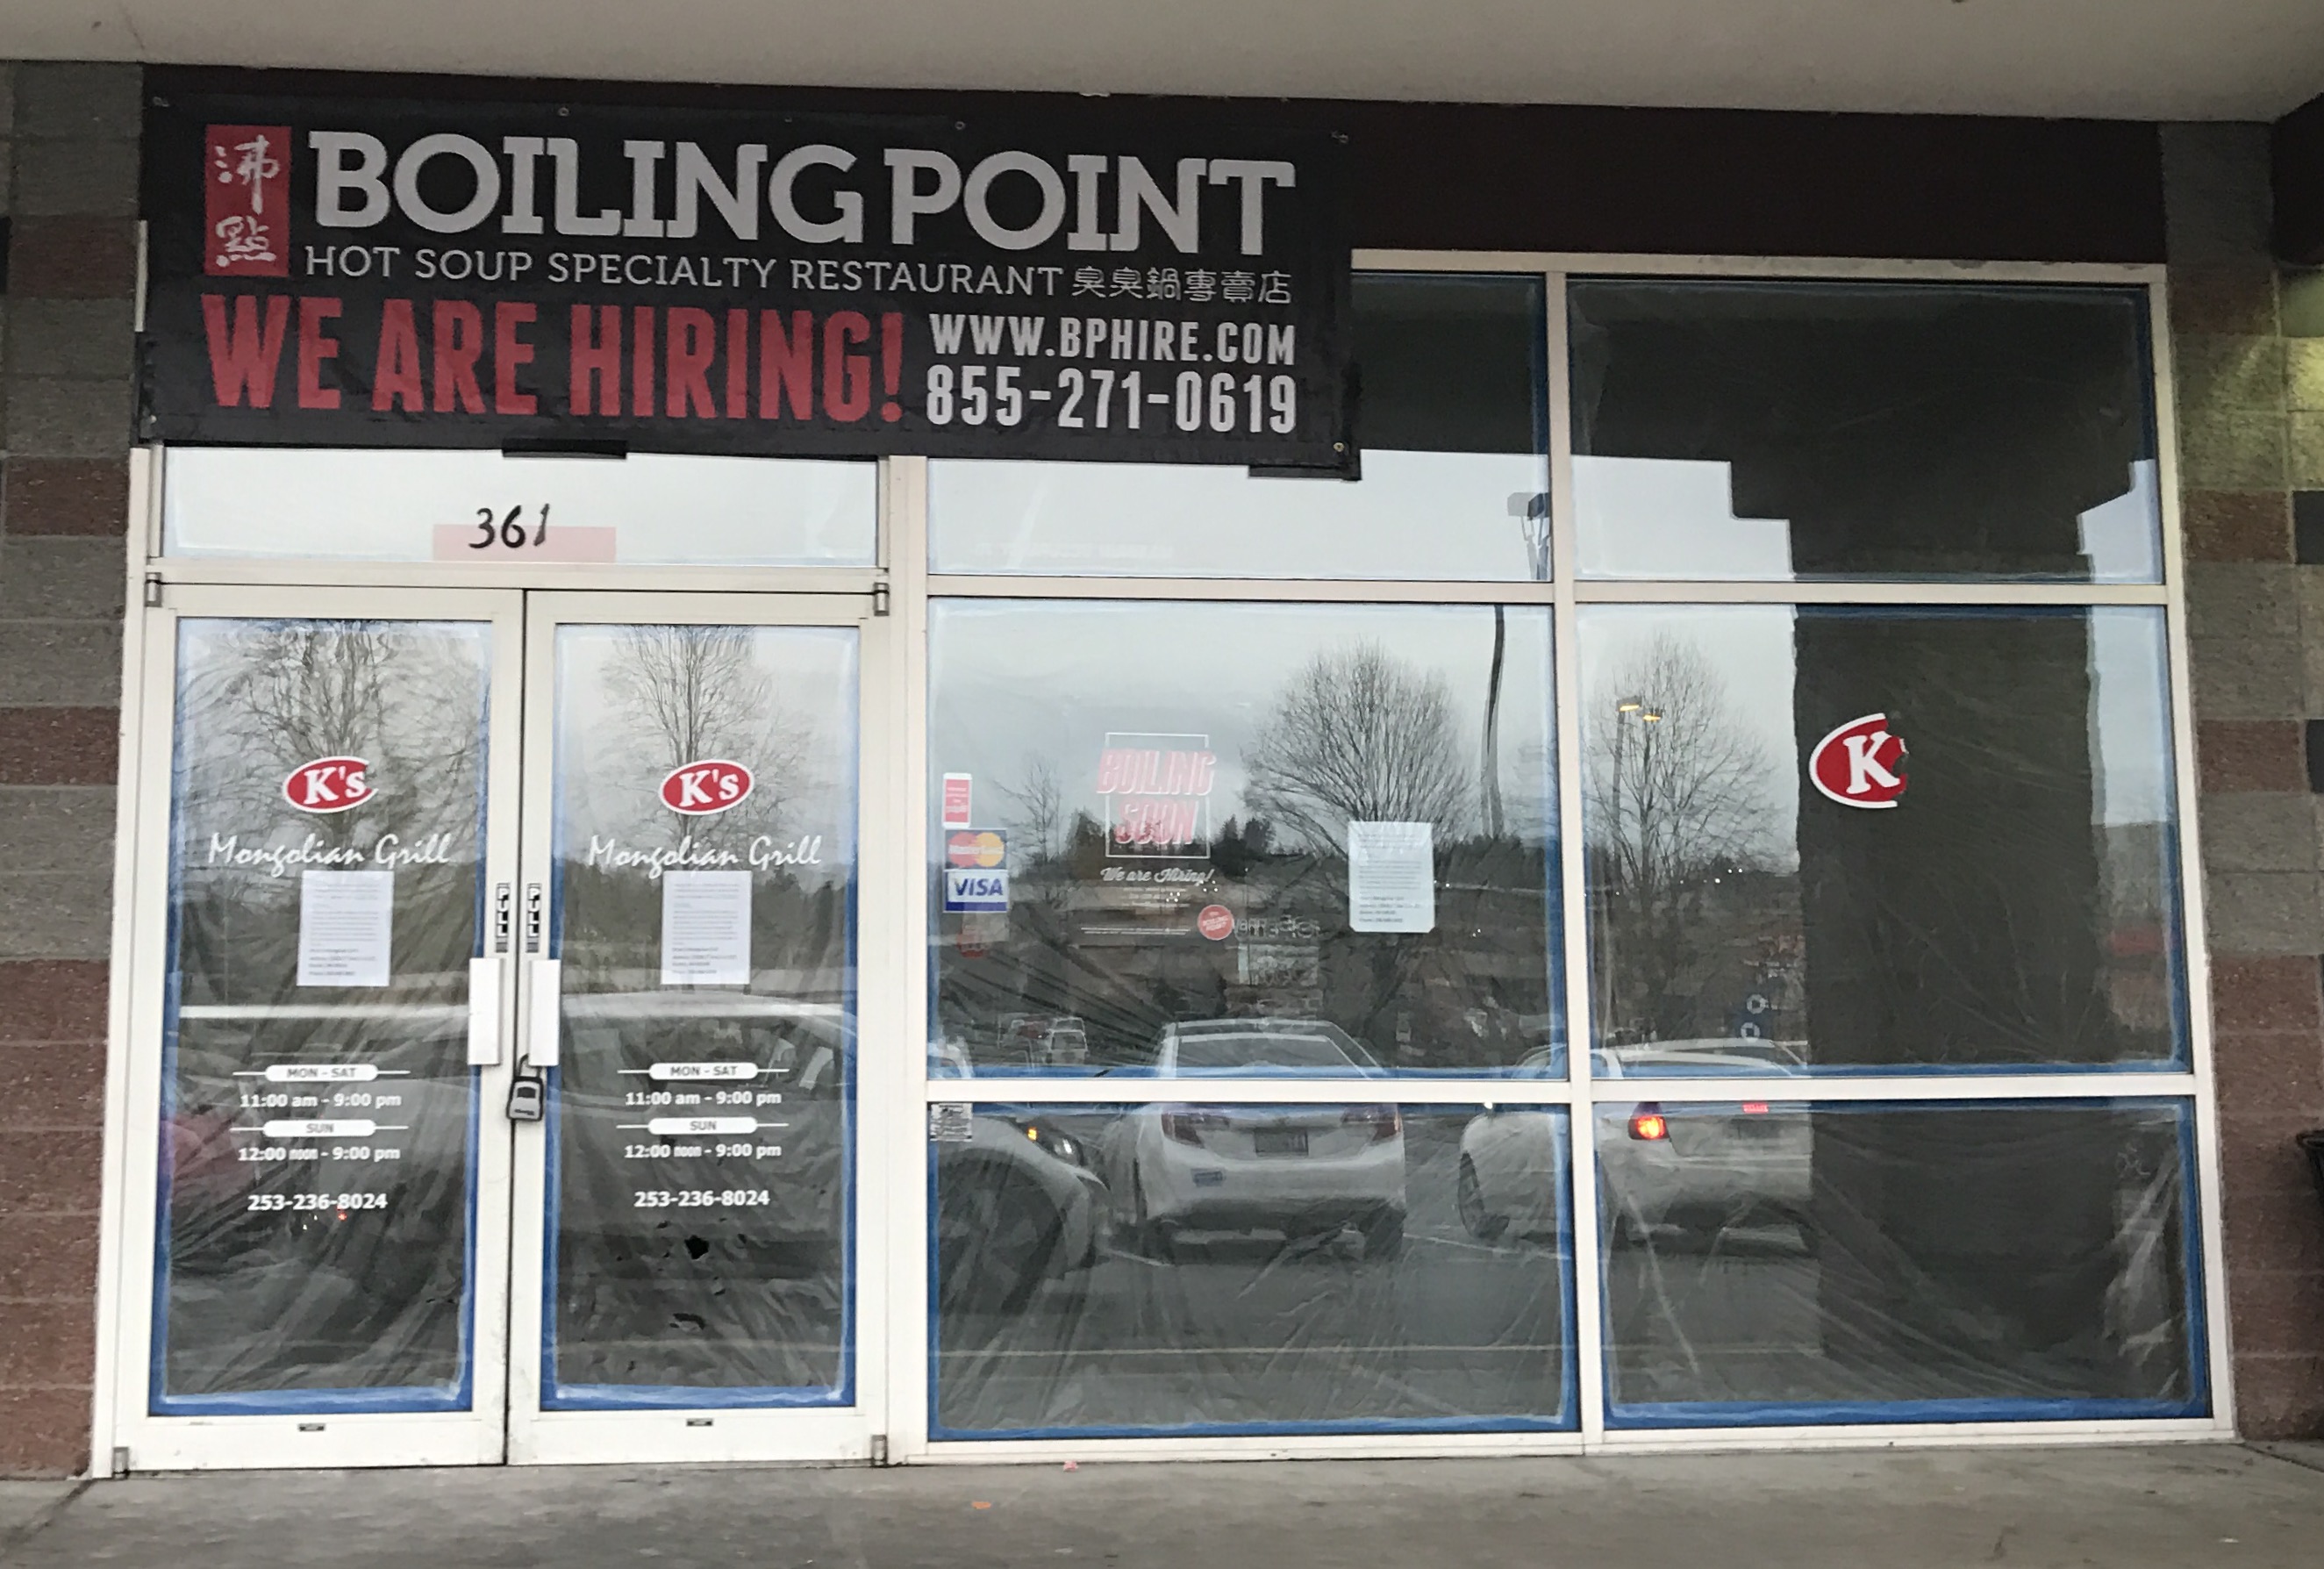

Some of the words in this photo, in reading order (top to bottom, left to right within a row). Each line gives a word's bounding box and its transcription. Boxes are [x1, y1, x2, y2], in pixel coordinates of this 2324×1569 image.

[308, 129, 865, 245] BOILING
[883, 148, 1297, 255] POINT
[304, 247, 400, 277] HOT
[415, 247, 533, 281] SOUP
[547, 252, 777, 289] SPECIALTY
[790, 259, 1064, 297] RESTAURANT
[1071, 265, 1292, 304] 臭臭鍋專賣店
[928, 312, 1297, 365] WWW.BPHIRE.COM
[201, 294, 343, 410] WE
[371, 298, 538, 415] ARE
[569, 304, 904, 423] HIRING!
[926, 364, 1297, 433] 855-271-0619
[468, 503, 550, 548] 361
[303, 765, 367, 805] K's
[679, 769, 740, 807] K's
[1097, 748, 1217, 796] BOILING
[1114, 797, 1199, 845] SOON
[207, 832, 365, 878] Mongolian
[374, 833, 452, 869] Grill
[588, 835, 739, 879] Mongolian
[748, 835, 823, 870] Grill
[954, 878, 1004, 896] VISA
[1100, 866, 1125, 882] We
[1126, 870, 1152, 882] are
[1154, 868, 1215, 887] Hiring!
[497, 887, 510, 937] PULL
[528, 887, 540, 937] PULL
[286, 1067, 318, 1078] MON
[331, 1066, 356, 1078] SAT
[669, 1065, 700, 1077] MON
[713, 1064, 739, 1076] SAT
[240, 1093, 288, 1107] 11:00
[291, 1095, 318, 1107] am
[333, 1093, 372, 1107] 9:00
[375, 1095, 402, 1109] pm
[625, 1091, 672, 1106] 11:00
[675, 1093, 701, 1106] am
[715, 1091, 753, 1105] 9:00
[755, 1093, 783, 1107] pm
[306, 1122, 335, 1134] SUN
[690, 1121, 717, 1131] SUN
[238, 1147, 287, 1162] 12:00
[332, 1146, 370, 1160] 9:00
[374, 1148, 401, 1163] pm
[624, 1144, 671, 1158] 12:00
[715, 1143, 753, 1157] 9:00
[755, 1145, 783, 1160] pm
[247, 1193, 389, 1211] 253-236-8024
[633, 1189, 770, 1207] 253-236-8024
